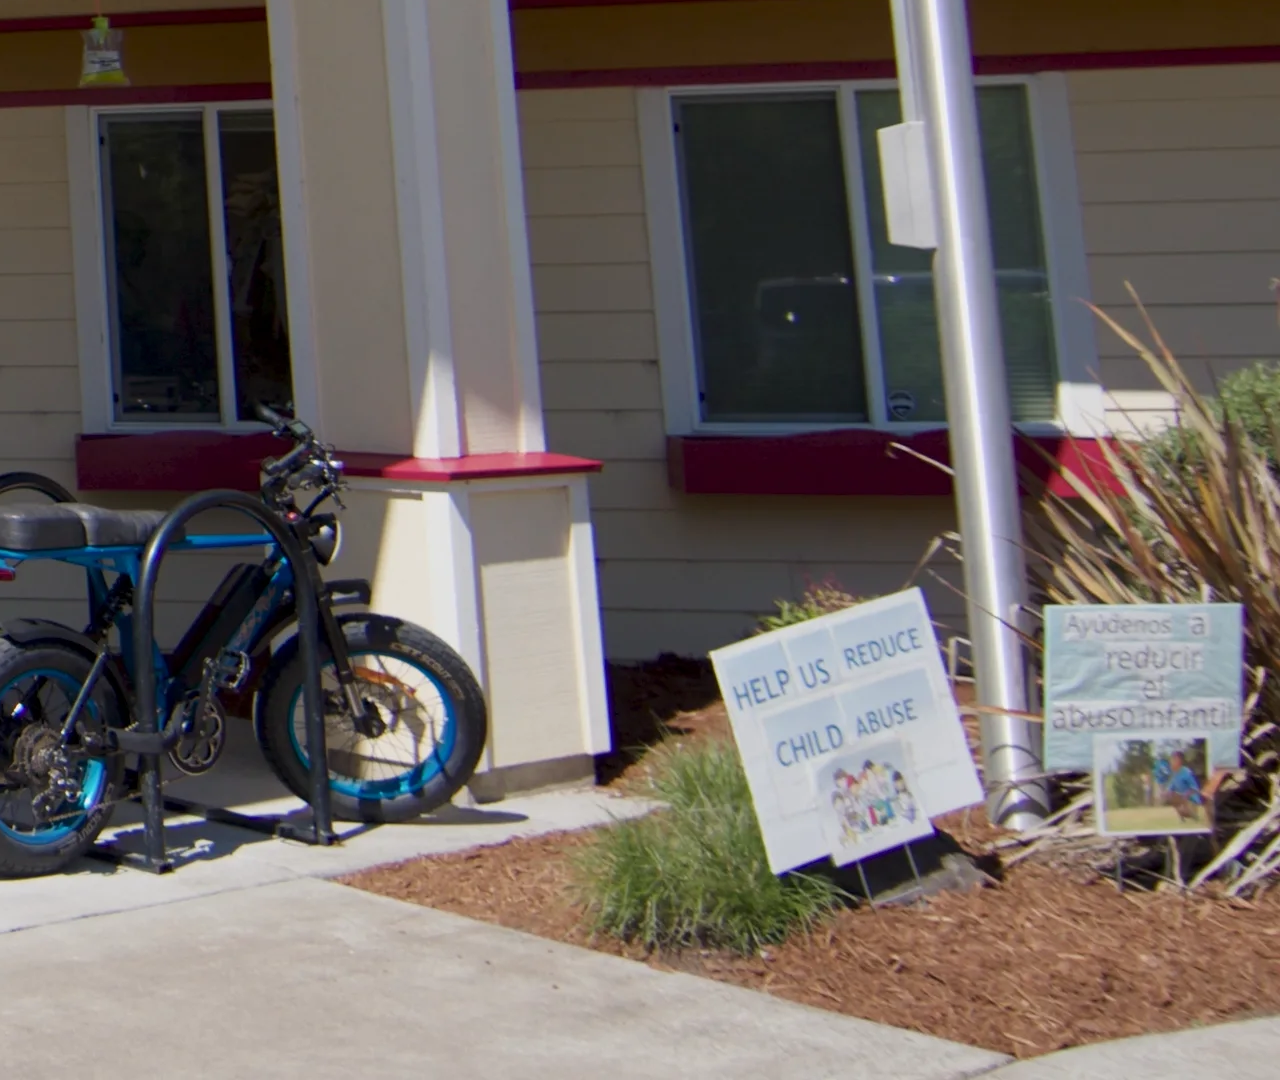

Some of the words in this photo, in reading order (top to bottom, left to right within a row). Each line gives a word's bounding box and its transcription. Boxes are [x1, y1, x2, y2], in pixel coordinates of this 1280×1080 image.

[1190, 615, 1206, 636] a
[733, 669, 790, 711] HELP
[798, 658, 831, 689] US
[843, 627, 923, 670] REDUCE
[1106, 644, 1203, 670] reducir
[1142, 674, 1166, 700] el
[1052, 703, 1135, 729] abuso
[1137, 702, 1235, 730] infantil
[776, 723, 844, 767] CHILD
[856, 697, 918, 738] ABUSE
